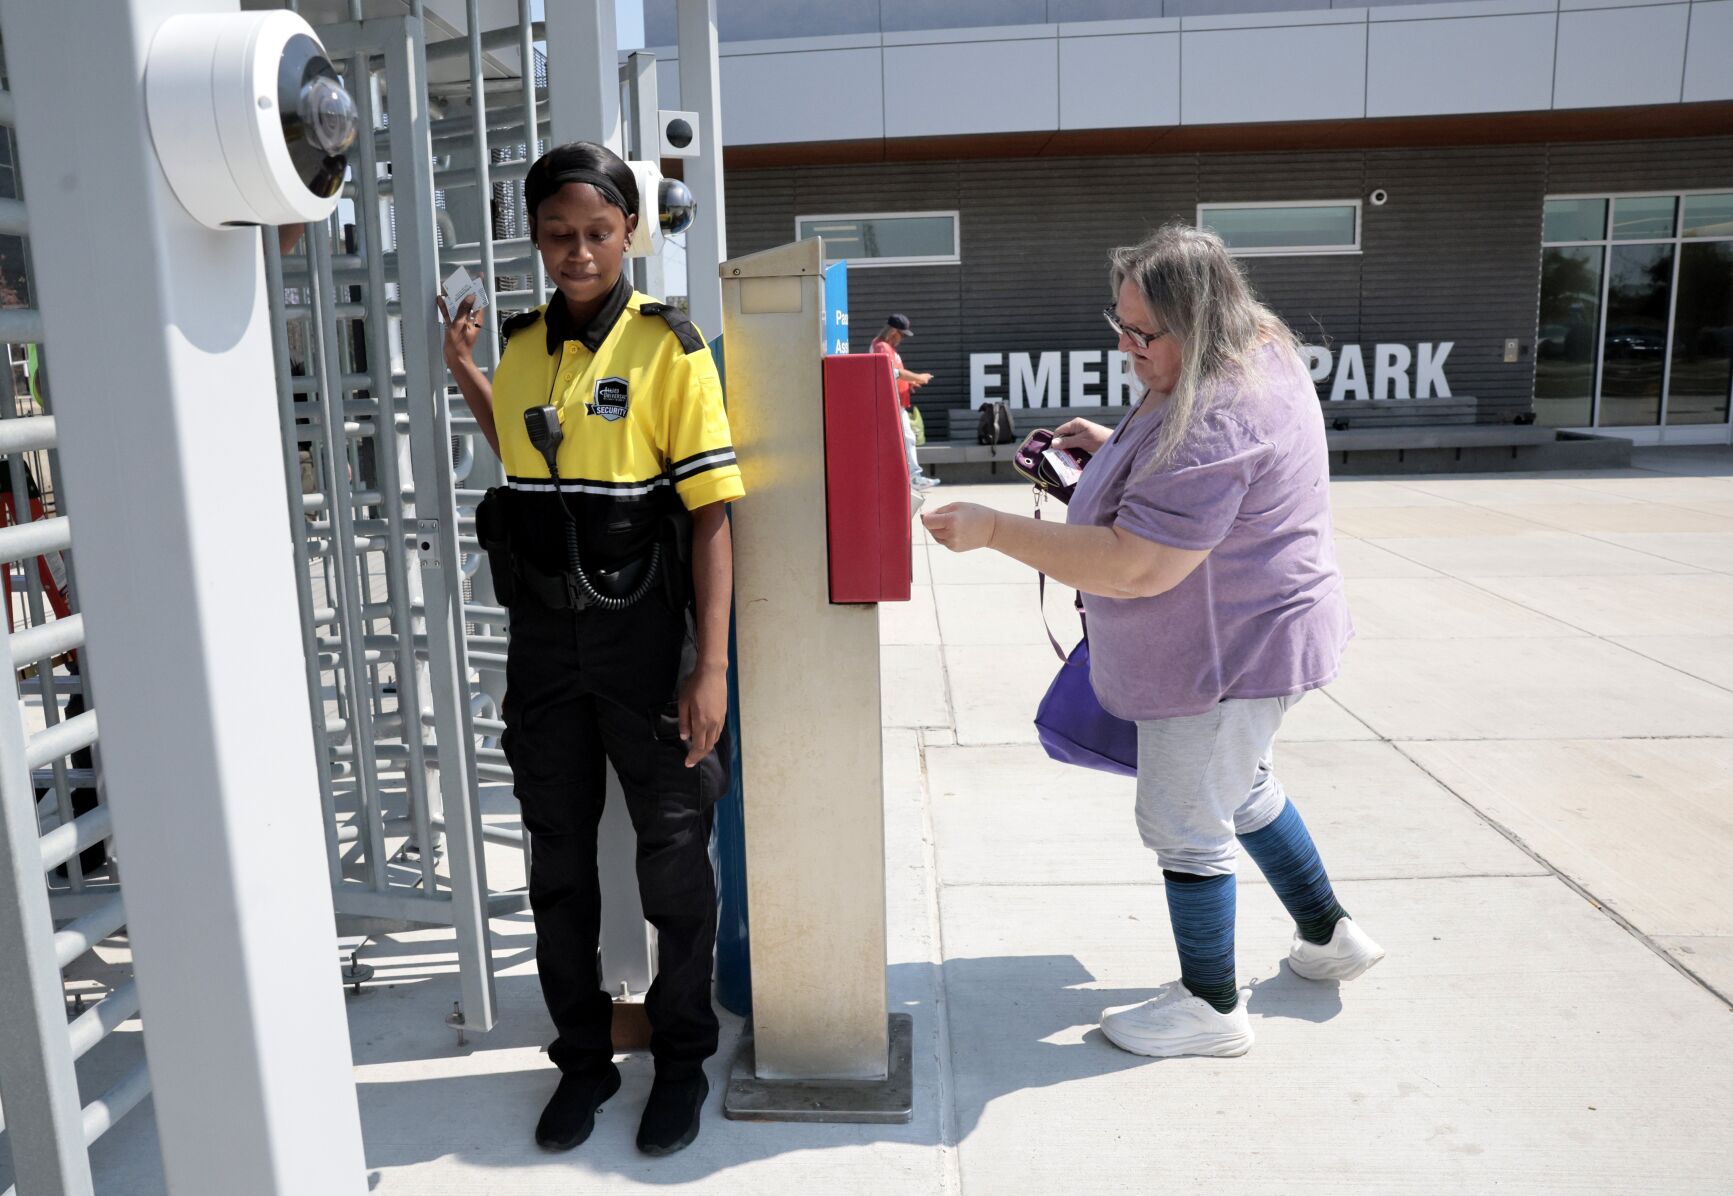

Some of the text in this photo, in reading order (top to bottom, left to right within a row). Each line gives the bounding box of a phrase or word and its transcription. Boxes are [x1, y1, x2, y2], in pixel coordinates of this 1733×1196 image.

[969, 342, 1455, 410] EMER PARK
[596, 406, 627, 417] SECURITY
